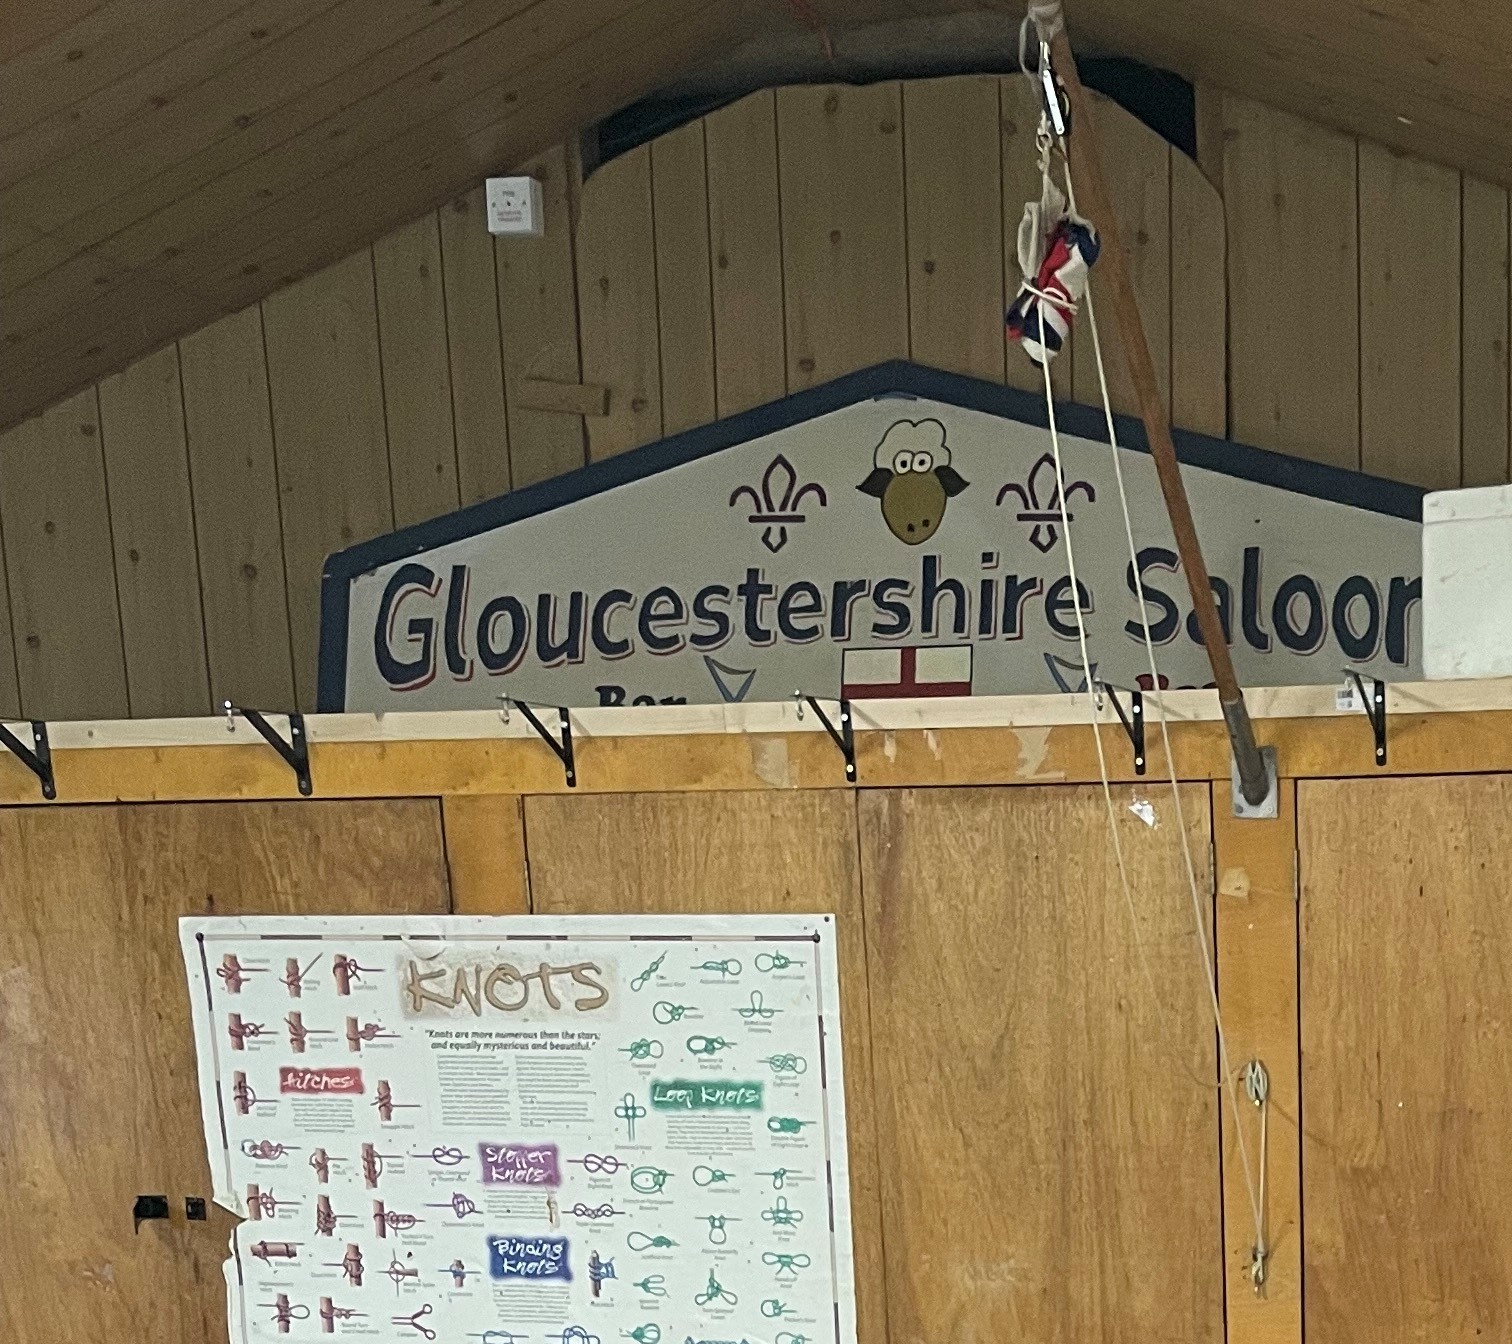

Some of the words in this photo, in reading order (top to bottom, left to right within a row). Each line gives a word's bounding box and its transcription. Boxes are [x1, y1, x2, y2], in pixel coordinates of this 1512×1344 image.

[374, 550, 1094, 691] Gloucestershire
[407, 960, 609, 1017] KNOTS
[454, 1031, 470, 1040] are
[539, 1031, 560, 1040] than
[561, 1031, 576, 1040] the
[430, 1041, 448, 1050] and
[449, 1041, 481, 1052] equally
[483, 1041, 530, 1052] mysterious
[531, 1041, 548, 1050] and
[700, 1086, 761, 1106] Knots
[490, 1166, 549, 1183] Knots
[493, 1239, 564, 1260] Binding
[502, 1257, 562, 1274] Knots
